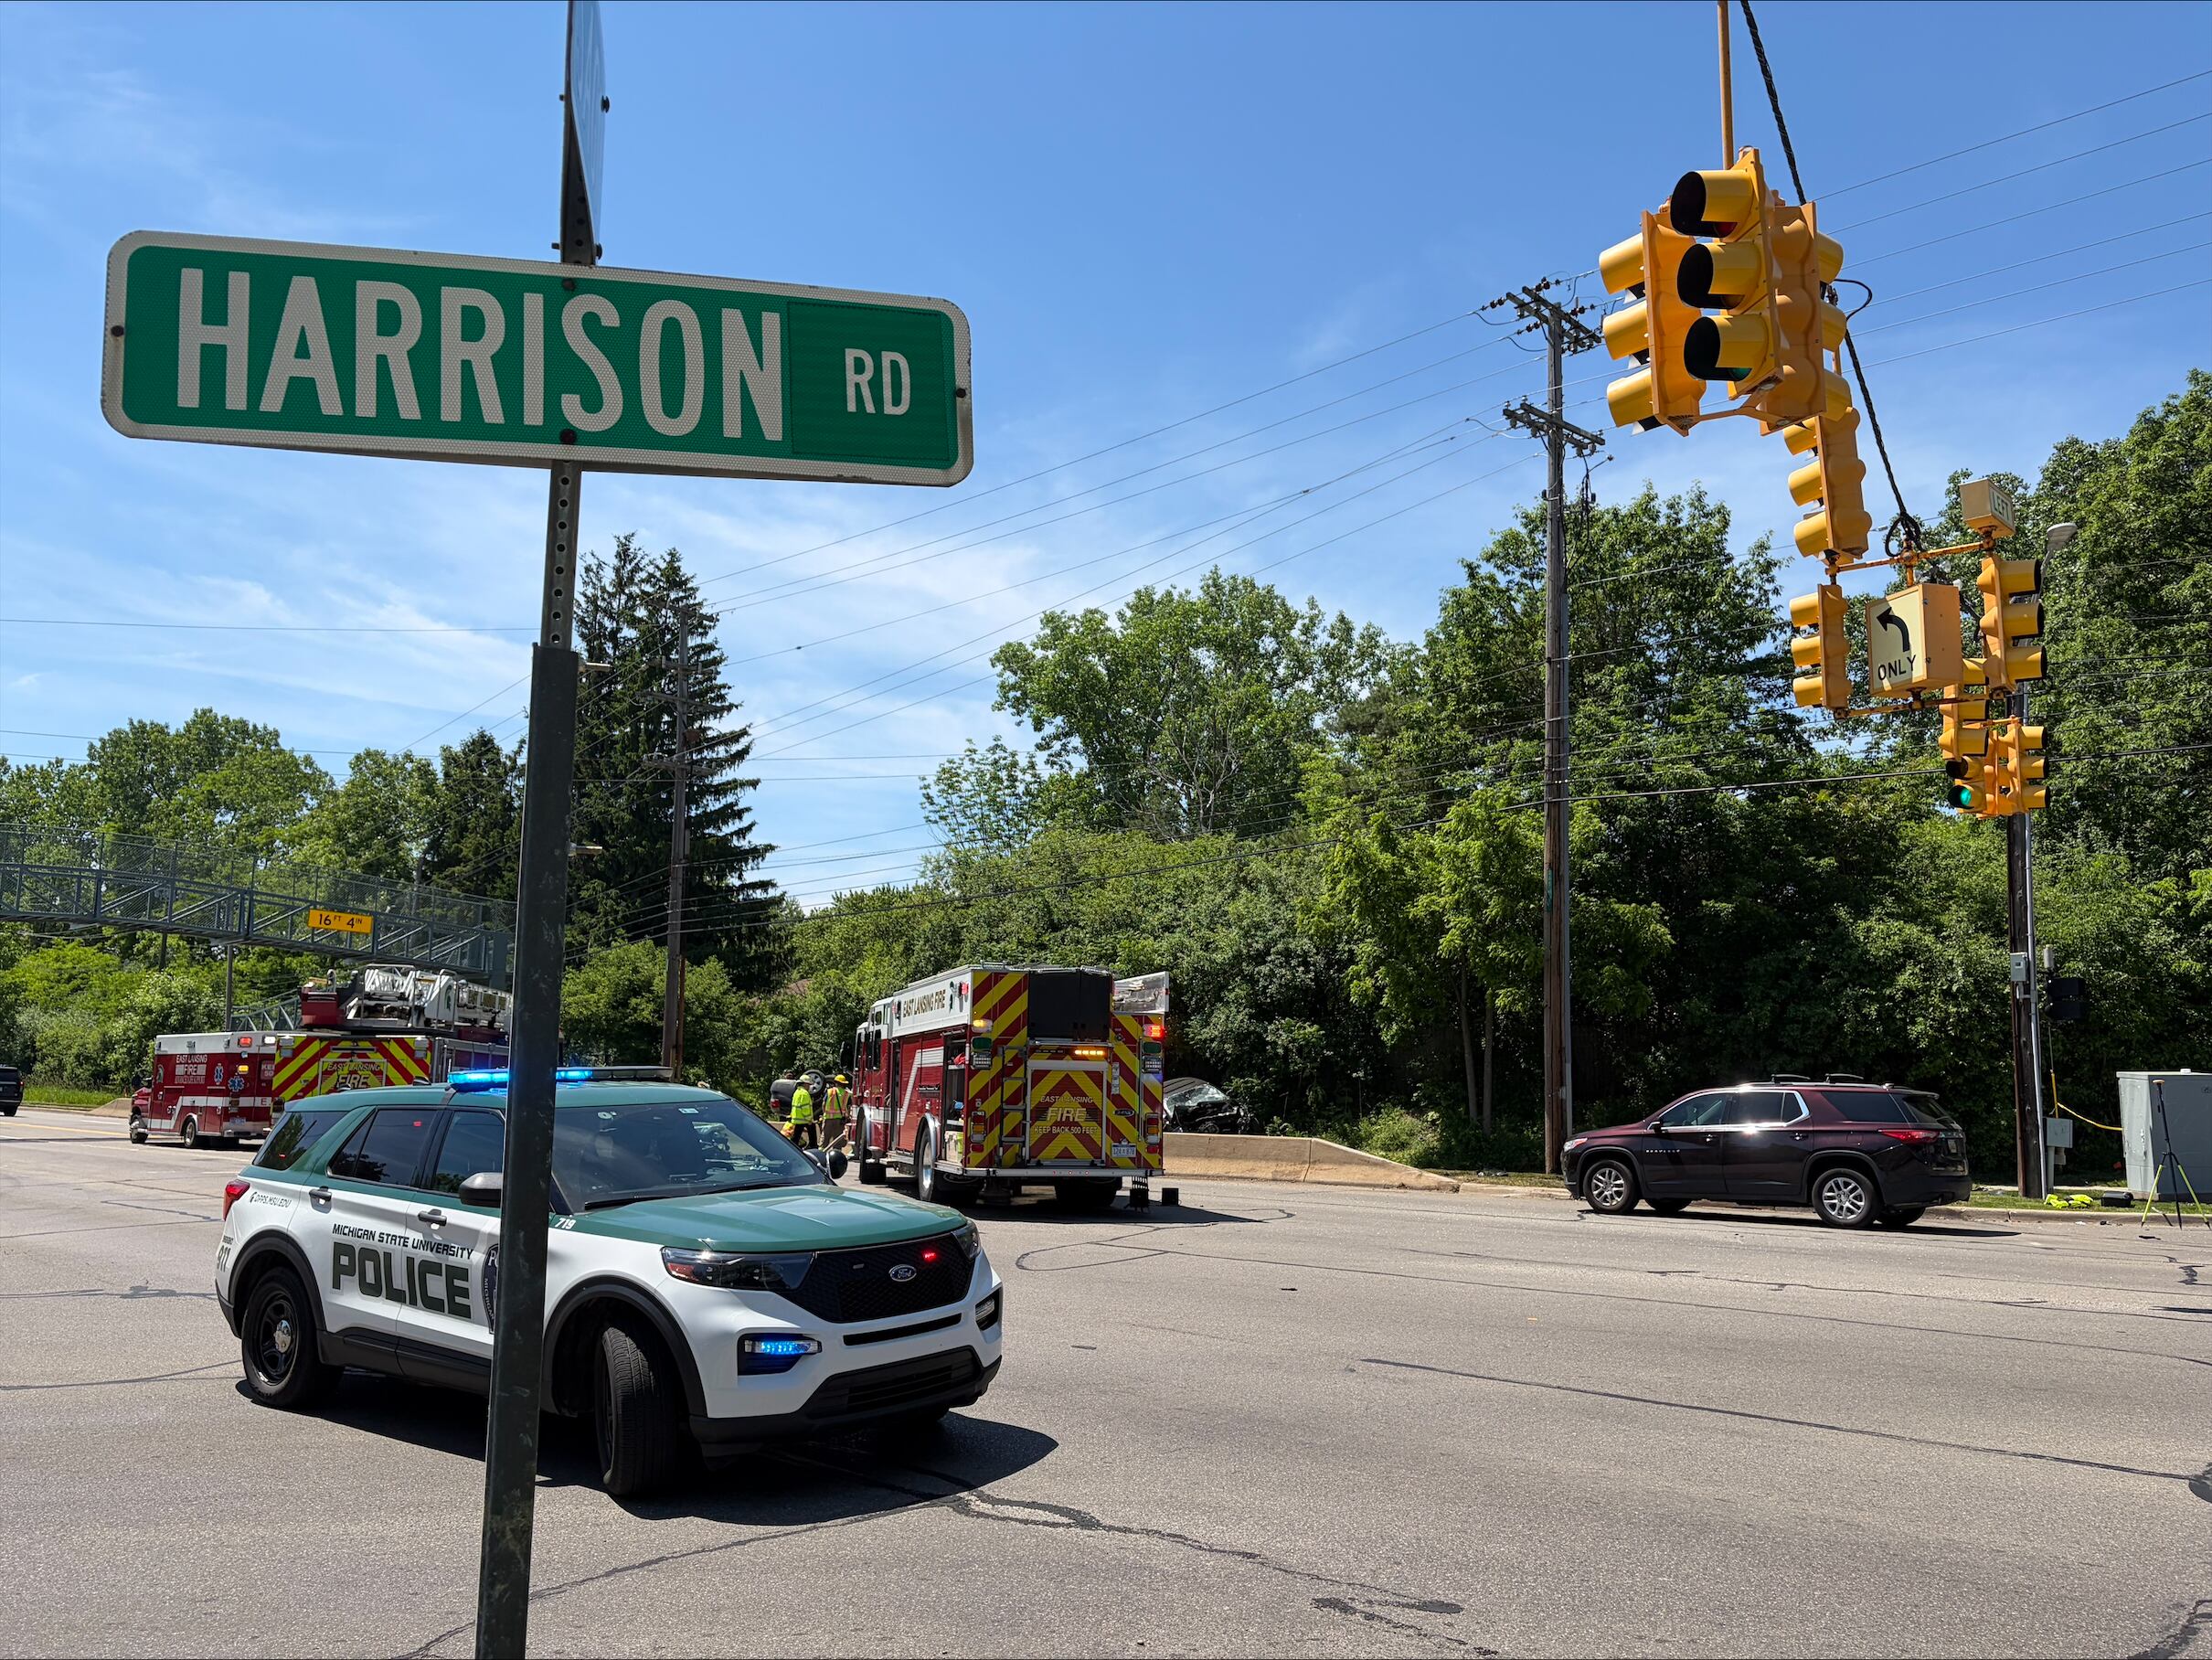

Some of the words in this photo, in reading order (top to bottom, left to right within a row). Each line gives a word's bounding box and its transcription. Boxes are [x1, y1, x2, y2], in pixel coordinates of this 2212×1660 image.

[177, 266, 783, 442] HARRISON
[845, 347, 911, 417] RD
[1993, 491, 2010, 521] LEFT
[1877, 654, 1917, 681] ONLY
[319, 913, 332, 926] 16
[346, 917, 355, 929] 4
[903, 998, 914, 1017] EAST
[914, 992, 934, 1015] LANSING
[934, 989, 946, 1011] FIRE
[175, 1054, 188, 1063] EAST
[187, 1054, 208, 1063] LANSING
[184, 1064, 197, 1076] FIRE
[327, 1062, 347, 1071] EAST
[348, 1062, 381, 1071] LANSING
[337, 1074, 370, 1089] FIRE
[1040, 1095, 1060, 1103] EAST
[1061, 1096, 1094, 1104] LANSING
[1047, 1107, 1088, 1122] FIRE
[1070, 1126, 1081, 1134] 500
[1082, 1126, 1098, 1134] FEET
[554, 1218, 577, 1229] 719
[332, 1223, 377, 1241] MICHIGAN
[378, 1232, 410, 1248] STATE
[411, 1238, 475, 1261] UNIVERSITY
[217, 1245, 232, 1272] 911
[332, 1241, 472, 1319] POLICE
